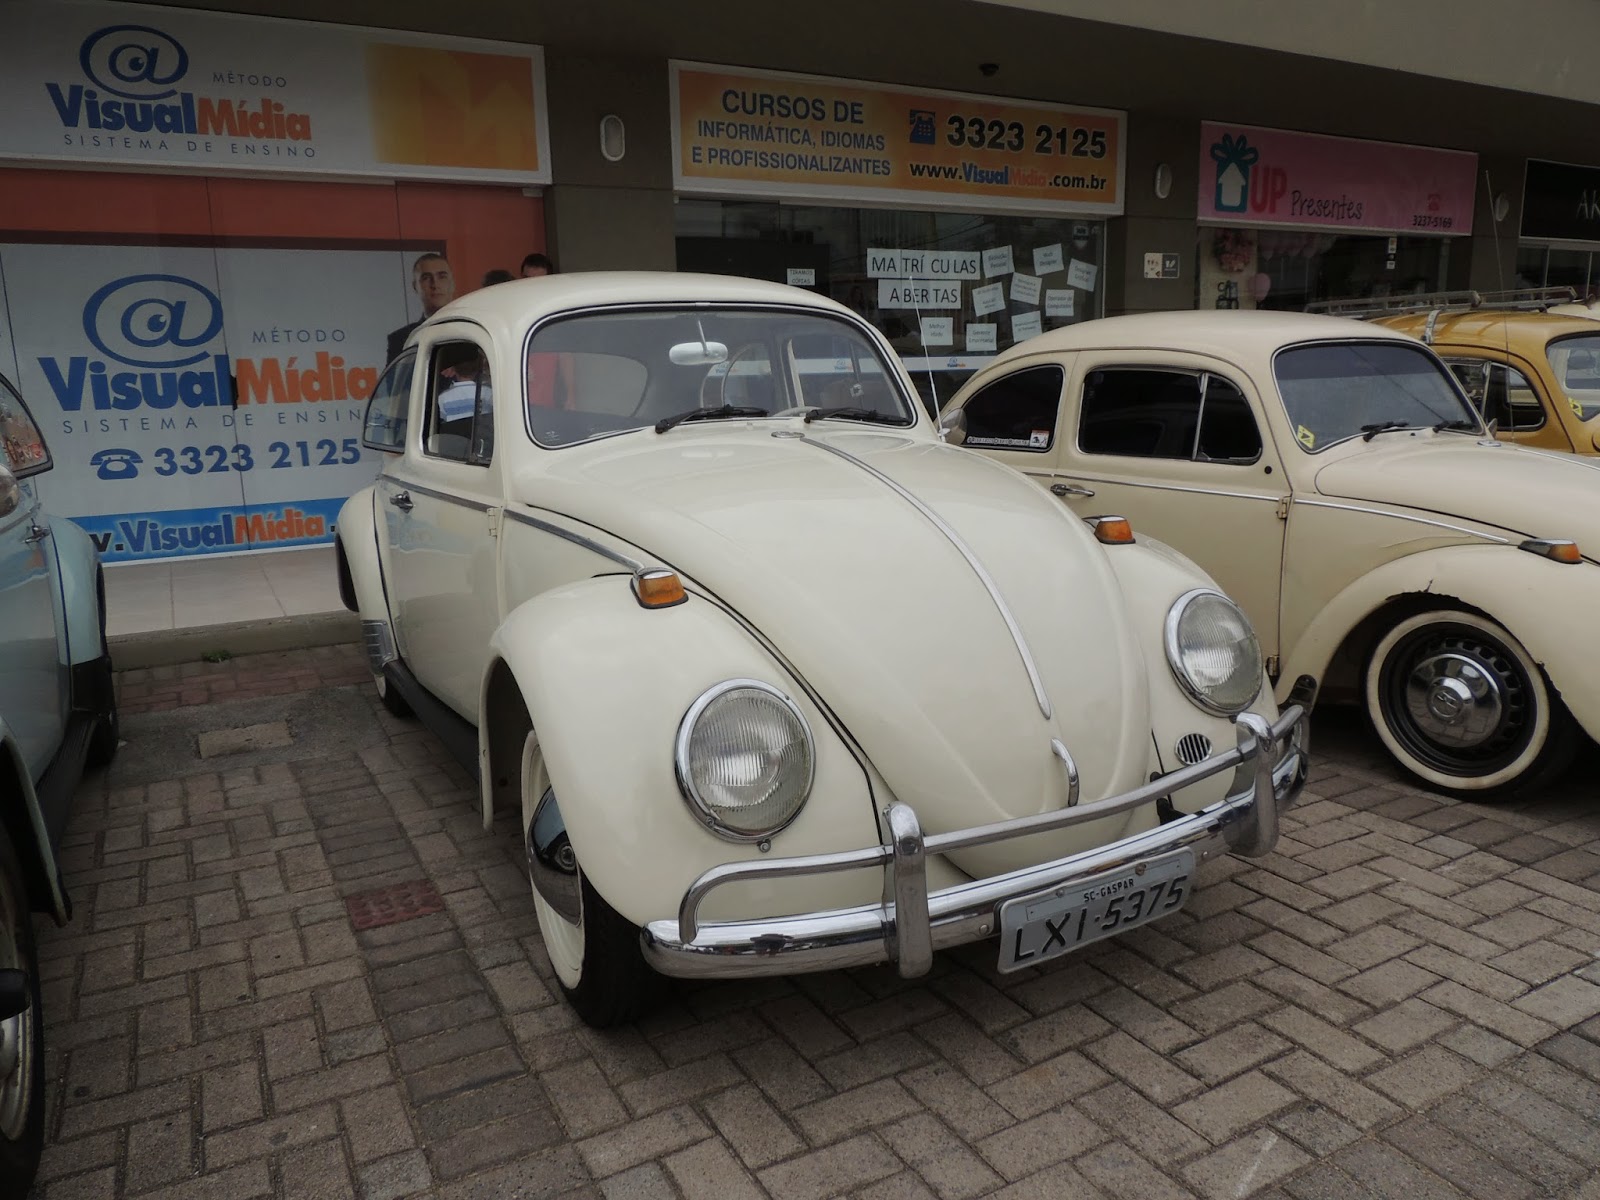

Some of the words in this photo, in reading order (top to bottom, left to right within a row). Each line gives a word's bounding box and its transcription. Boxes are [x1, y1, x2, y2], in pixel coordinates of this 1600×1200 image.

[213, 70, 287, 89] MÉTODO
[46, 82, 312, 141] VisualMídia
[722, 90, 825, 122] CURSOS
[834, 101, 864, 124] DE
[64, 134, 169, 151] SISTEMA
[187, 141, 213, 153] DE
[231, 143, 317, 158] ENSINO
[699, 120, 816, 149] INFORMÁTICA,
[821, 131, 885, 151] IDIOMAS
[947, 116, 1025, 152] 3323
[1035, 124, 1107, 159] 2125
[692, 147, 703, 163] E
[708, 148, 891, 177] PROFISSIONALIZANTES
[1251, 165, 1287, 214] UP
[1291, 190, 1363, 221] Presentes
[1412, 214, 1453, 229] 3237-5169
[889, 287, 958, 304] ABERTAS
[252, 326, 346, 344] MÉTODO
[37, 351, 378, 411] VisualMídia
[63, 415, 197, 434] SISTEMA
[223, 412, 253, 428] DE
[154, 443, 254, 477] 3323
[269, 437, 361, 470] 2125
[1084, 878, 1134, 902] SC-GASPAR
[1014, 876, 1188, 962] LXI-5375
